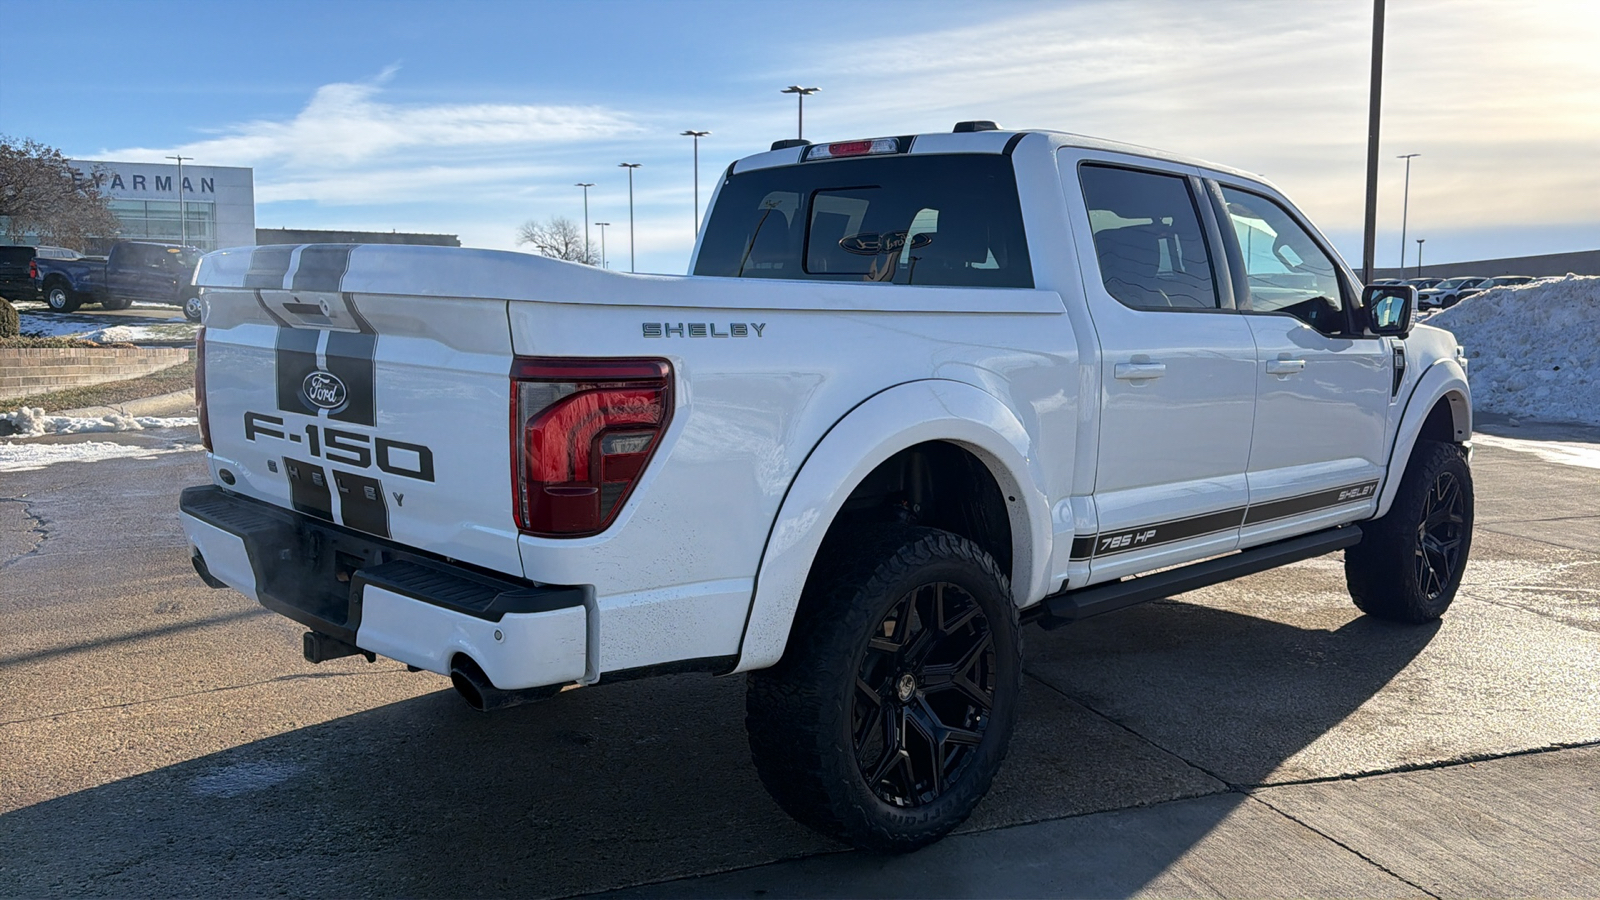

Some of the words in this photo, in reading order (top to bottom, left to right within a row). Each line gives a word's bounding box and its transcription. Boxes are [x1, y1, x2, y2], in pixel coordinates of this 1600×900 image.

[642, 322, 766, 338] SHELBY
[309, 376, 338, 403] Ford
[244, 411, 436, 483] F-150
[1337, 484, 1376, 501] SHELBY
[1134, 529, 1157, 544] HP
